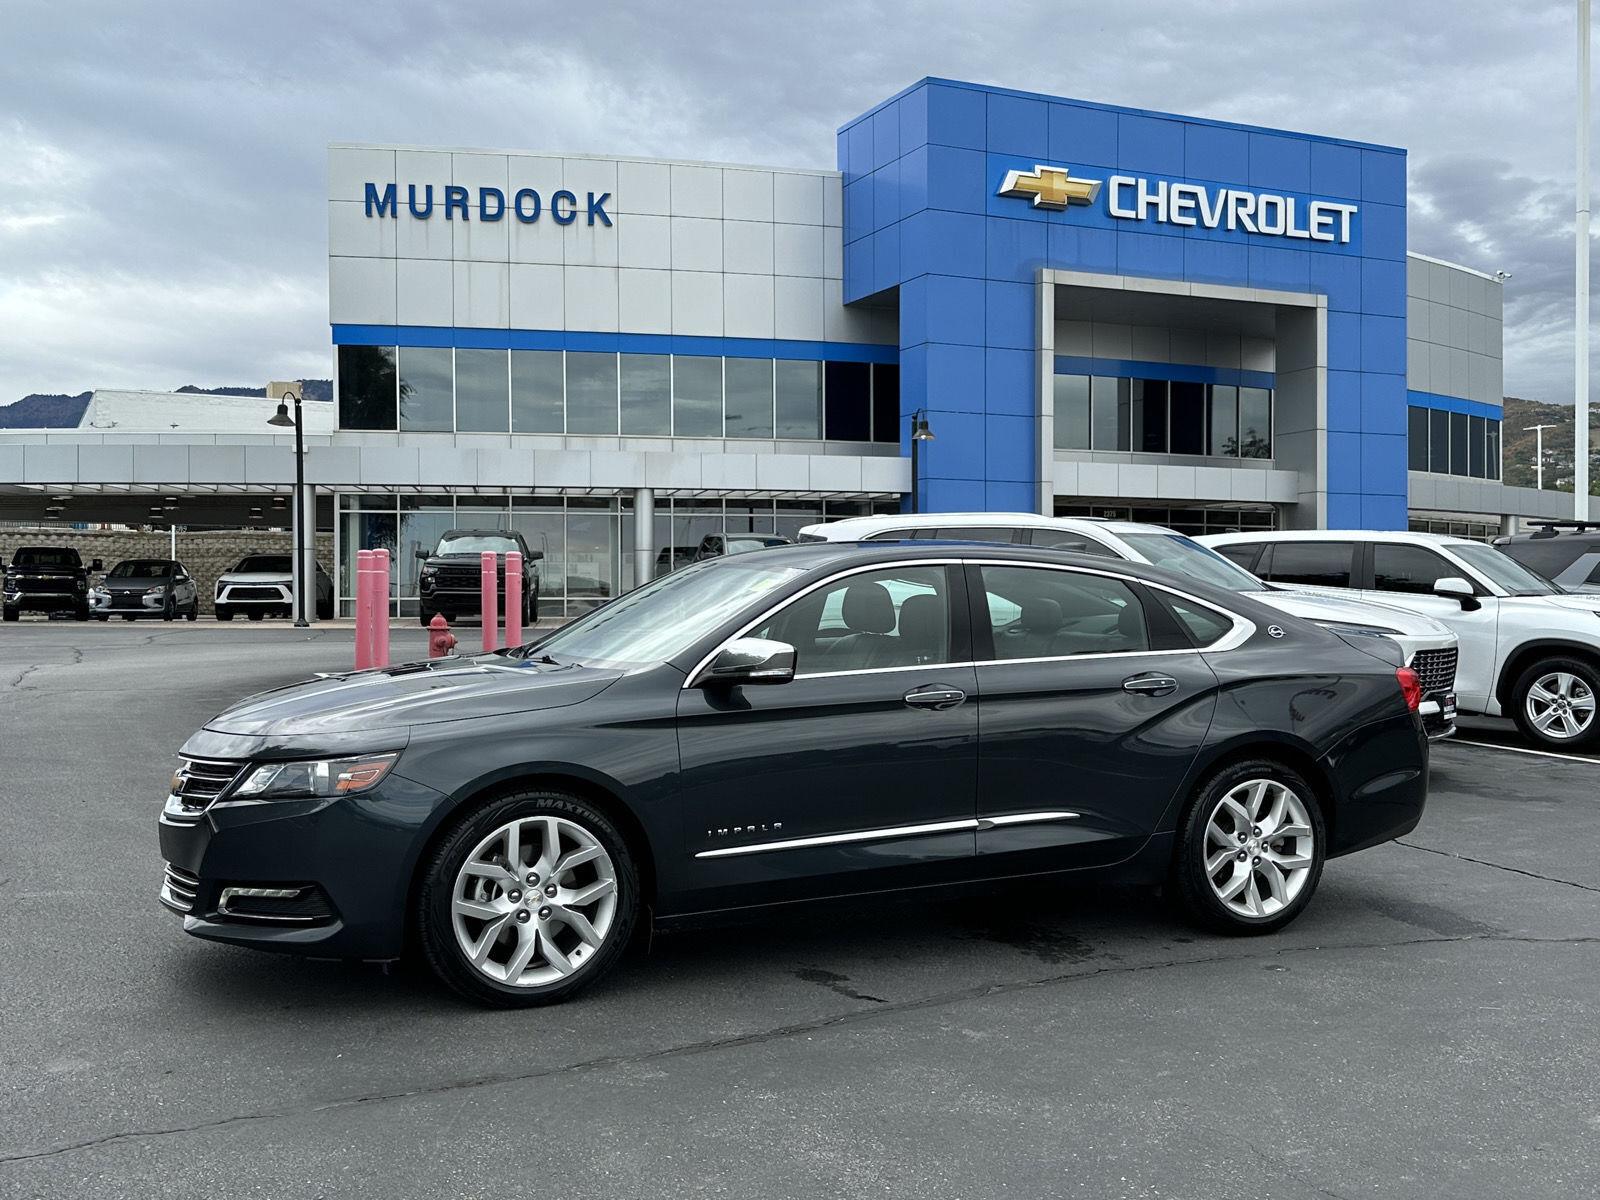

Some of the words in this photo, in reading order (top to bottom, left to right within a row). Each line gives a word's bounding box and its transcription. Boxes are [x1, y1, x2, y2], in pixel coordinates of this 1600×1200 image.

[364, 182, 613, 228] MURDOCK
[1108, 174, 1358, 244] CHEVROLET
[707, 822, 782, 837] IMPALA
